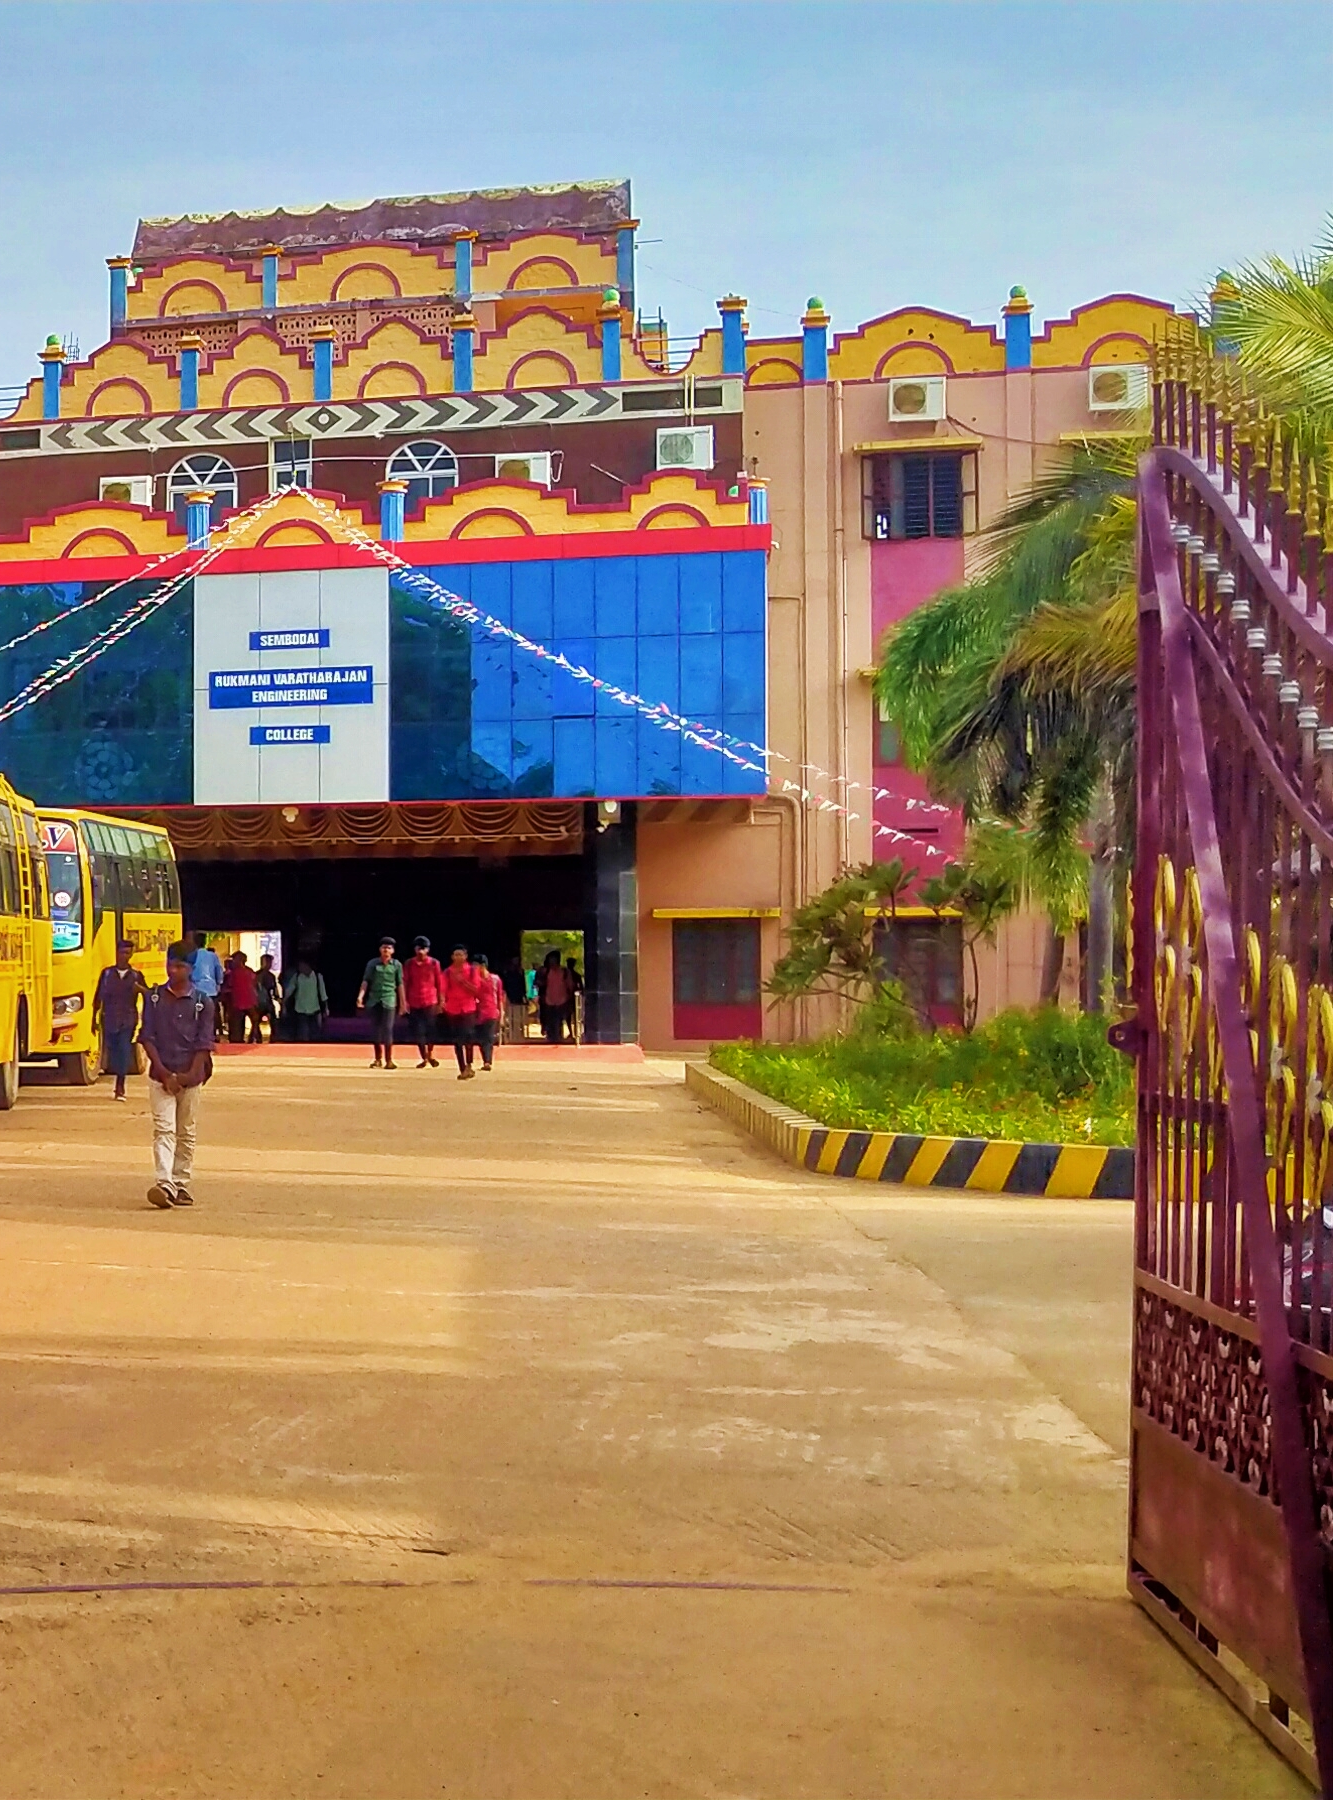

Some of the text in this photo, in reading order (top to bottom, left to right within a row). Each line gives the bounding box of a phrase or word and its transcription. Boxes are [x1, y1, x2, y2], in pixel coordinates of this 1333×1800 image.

[259, 632, 320, 647] SEMBODAI
[214, 669, 368, 688] RUKMANI VARATHARAJAN
[251, 688, 329, 703] ENGINEERING
[265, 728, 315, 741] COLLEGE
